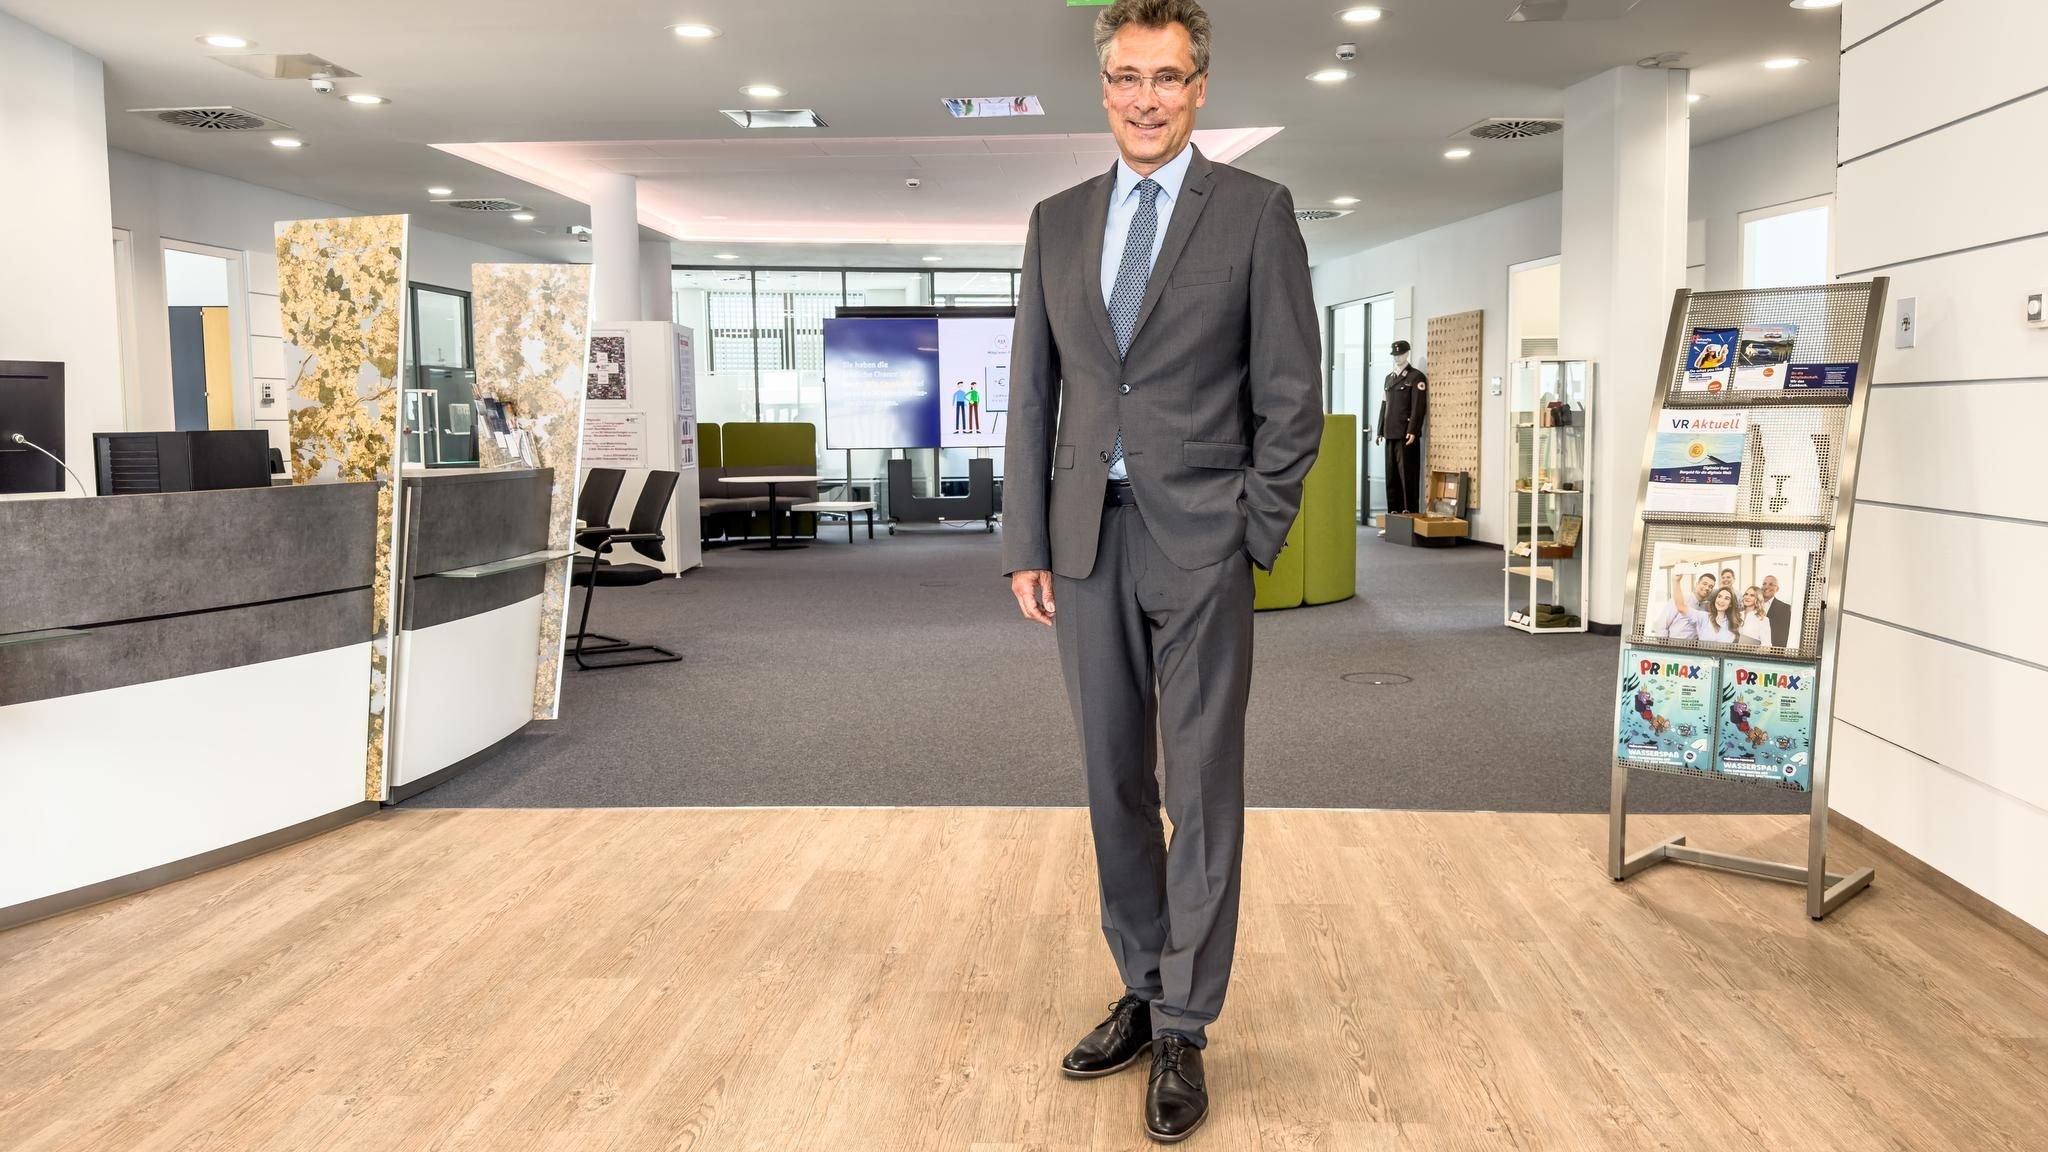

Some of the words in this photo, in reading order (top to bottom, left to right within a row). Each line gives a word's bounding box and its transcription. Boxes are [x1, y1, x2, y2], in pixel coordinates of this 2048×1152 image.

[877, 361, 889, 369] die
[1672, 419, 1690, 429] VR
[1691, 418, 1741, 430] Aktuell
[1640, 659, 1701, 680] PRIMAX
[1735, 668, 1801, 690] PRIMAX
